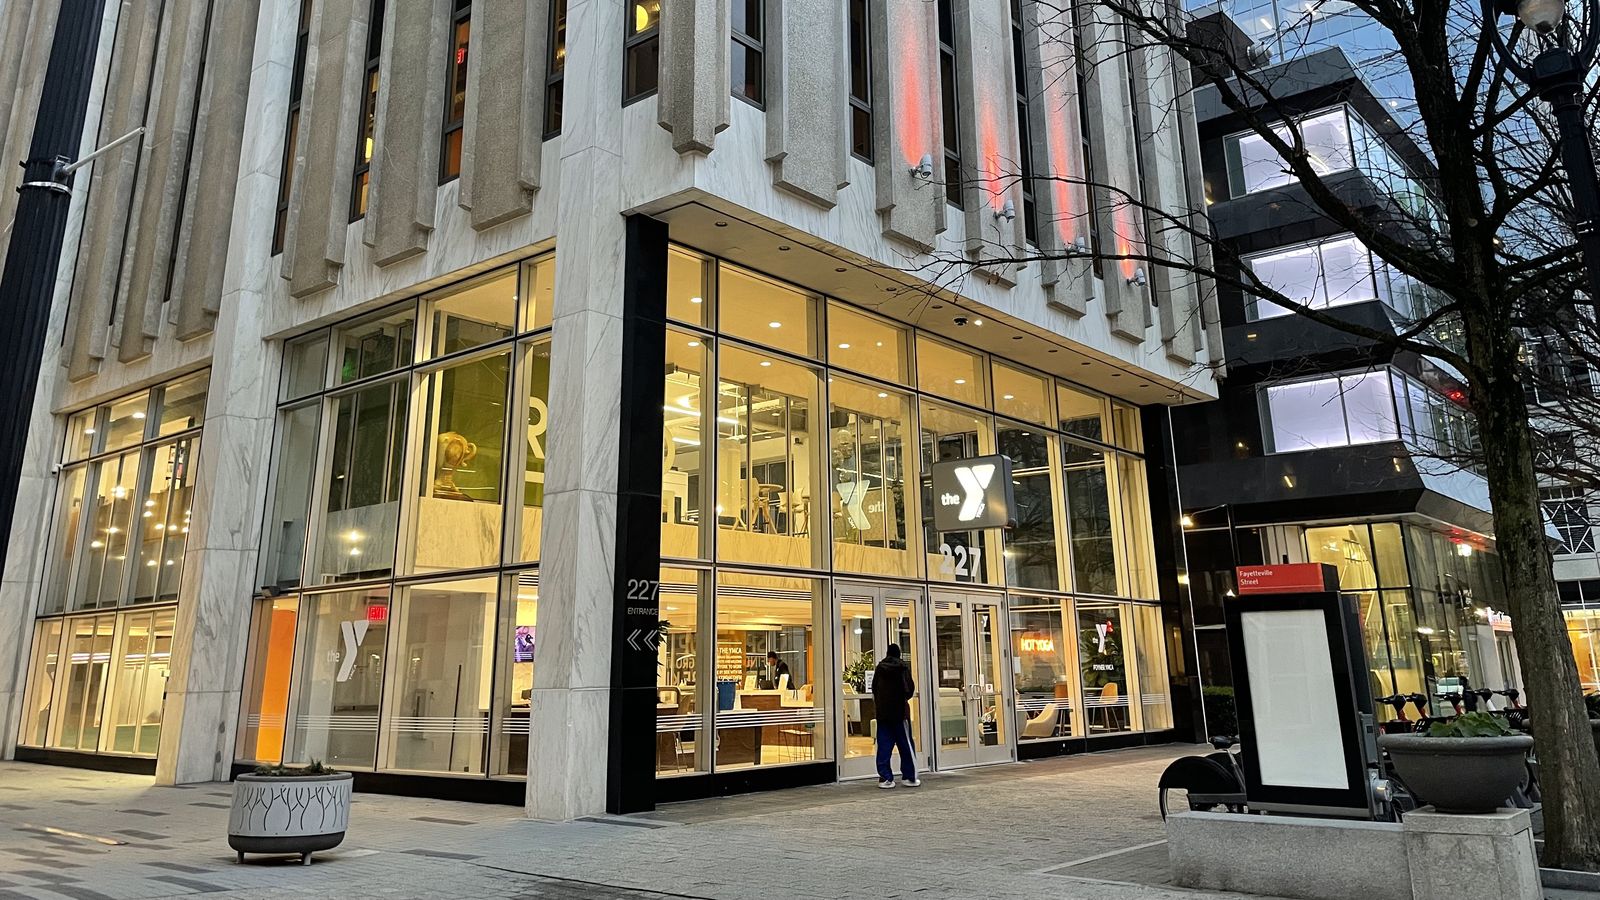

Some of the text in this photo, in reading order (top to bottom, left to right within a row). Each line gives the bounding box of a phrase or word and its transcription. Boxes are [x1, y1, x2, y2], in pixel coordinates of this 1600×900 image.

[941, 464, 996, 521] the Y
[939, 543, 982, 577] 227
[627, 579, 660, 600] 227
[370, 607, 387, 620] EXIT
[627, 607, 659, 615] ENTRANCE
[336, 620, 370, 683] Y
[1021, 638, 1055, 651] HOT YOGA
